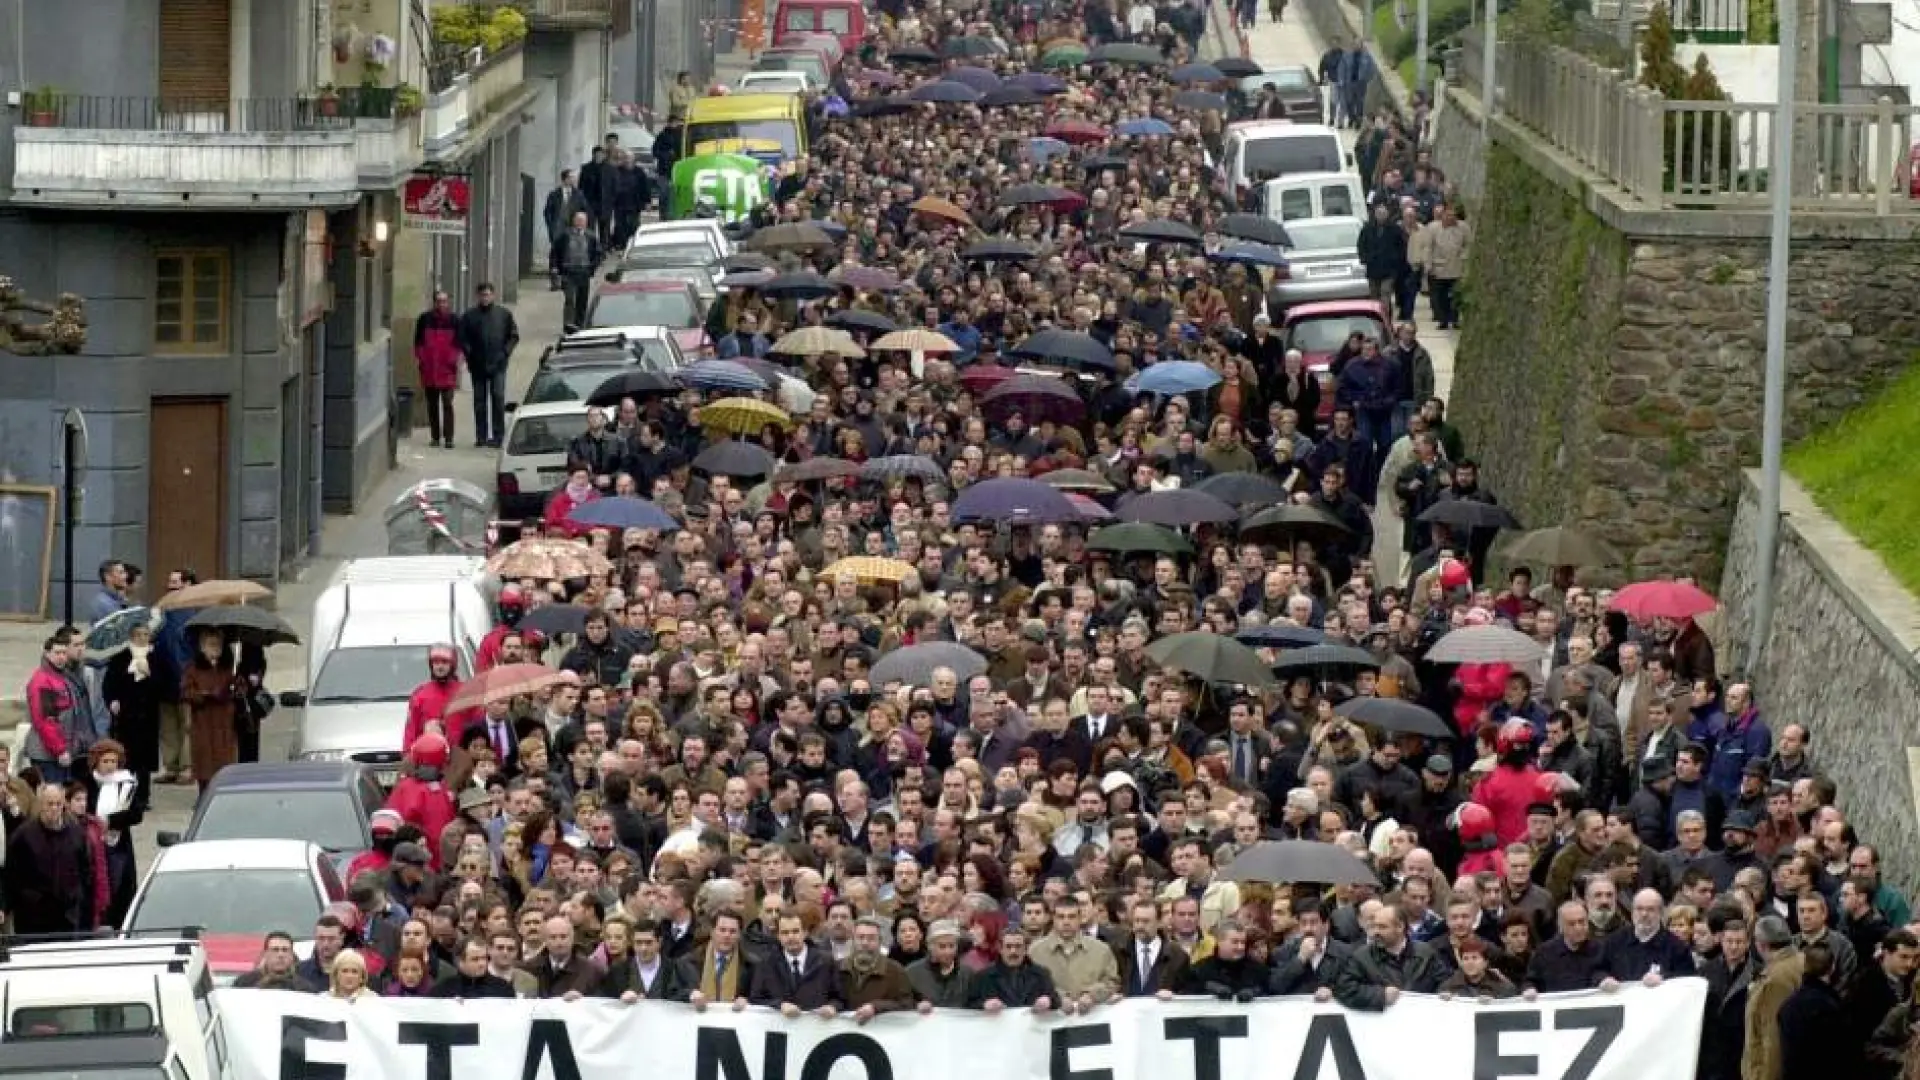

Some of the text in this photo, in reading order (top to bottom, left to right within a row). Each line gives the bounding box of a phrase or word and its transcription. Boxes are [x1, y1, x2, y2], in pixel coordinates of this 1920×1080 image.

[693, 168, 763, 211] ETA
[279, 1014, 583, 1080] ETA
[1049, 1013, 1368, 1080] ETA
